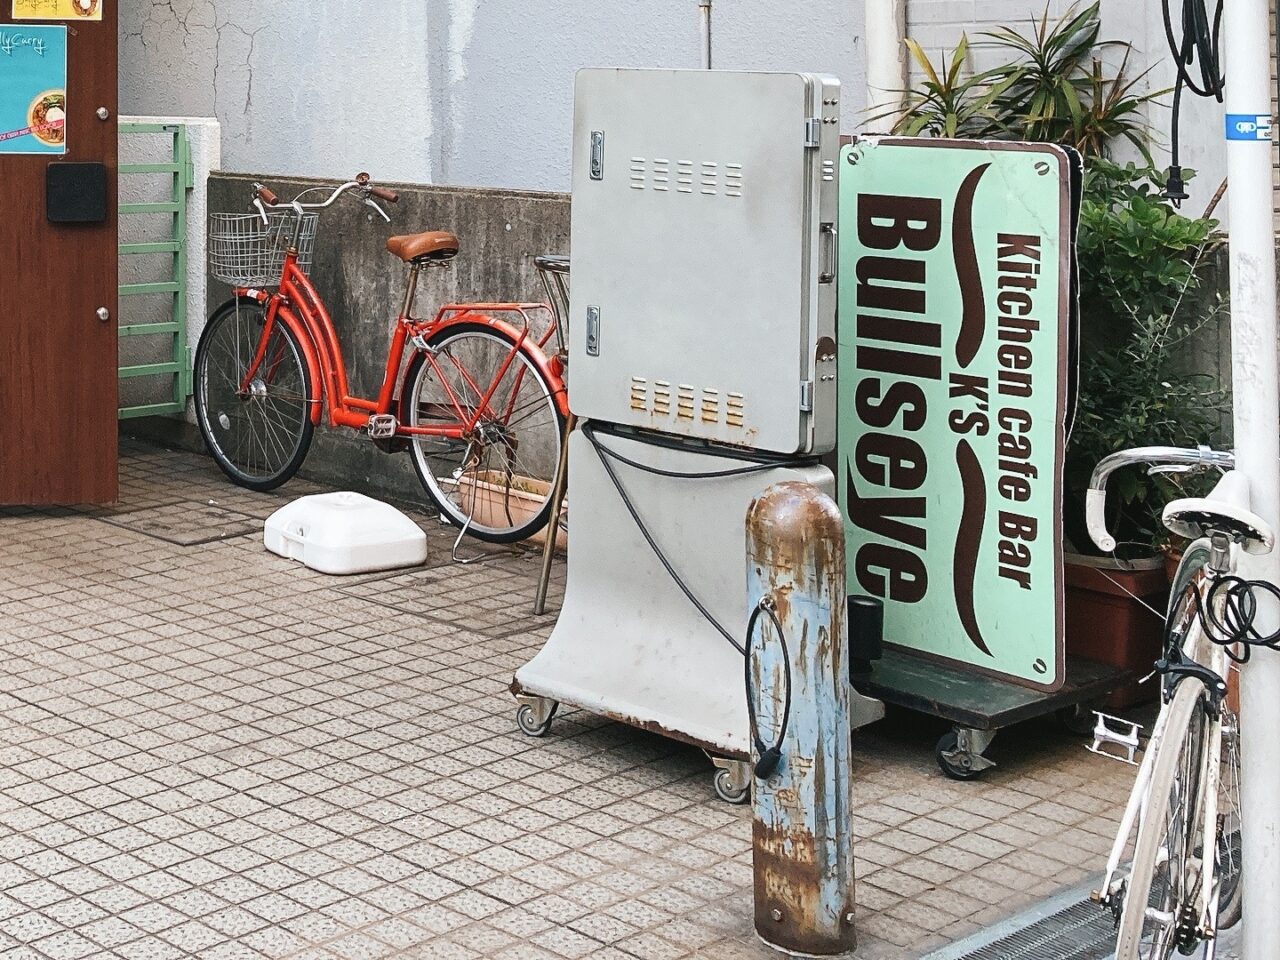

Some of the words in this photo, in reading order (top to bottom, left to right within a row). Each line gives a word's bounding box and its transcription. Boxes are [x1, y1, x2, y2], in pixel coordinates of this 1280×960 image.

[997, 233, 1041, 397] Kitchen
[846, 193, 942, 605] Bullseye
[997, 405, 1038, 504] cafe
[997, 510, 1038, 591] Bar
